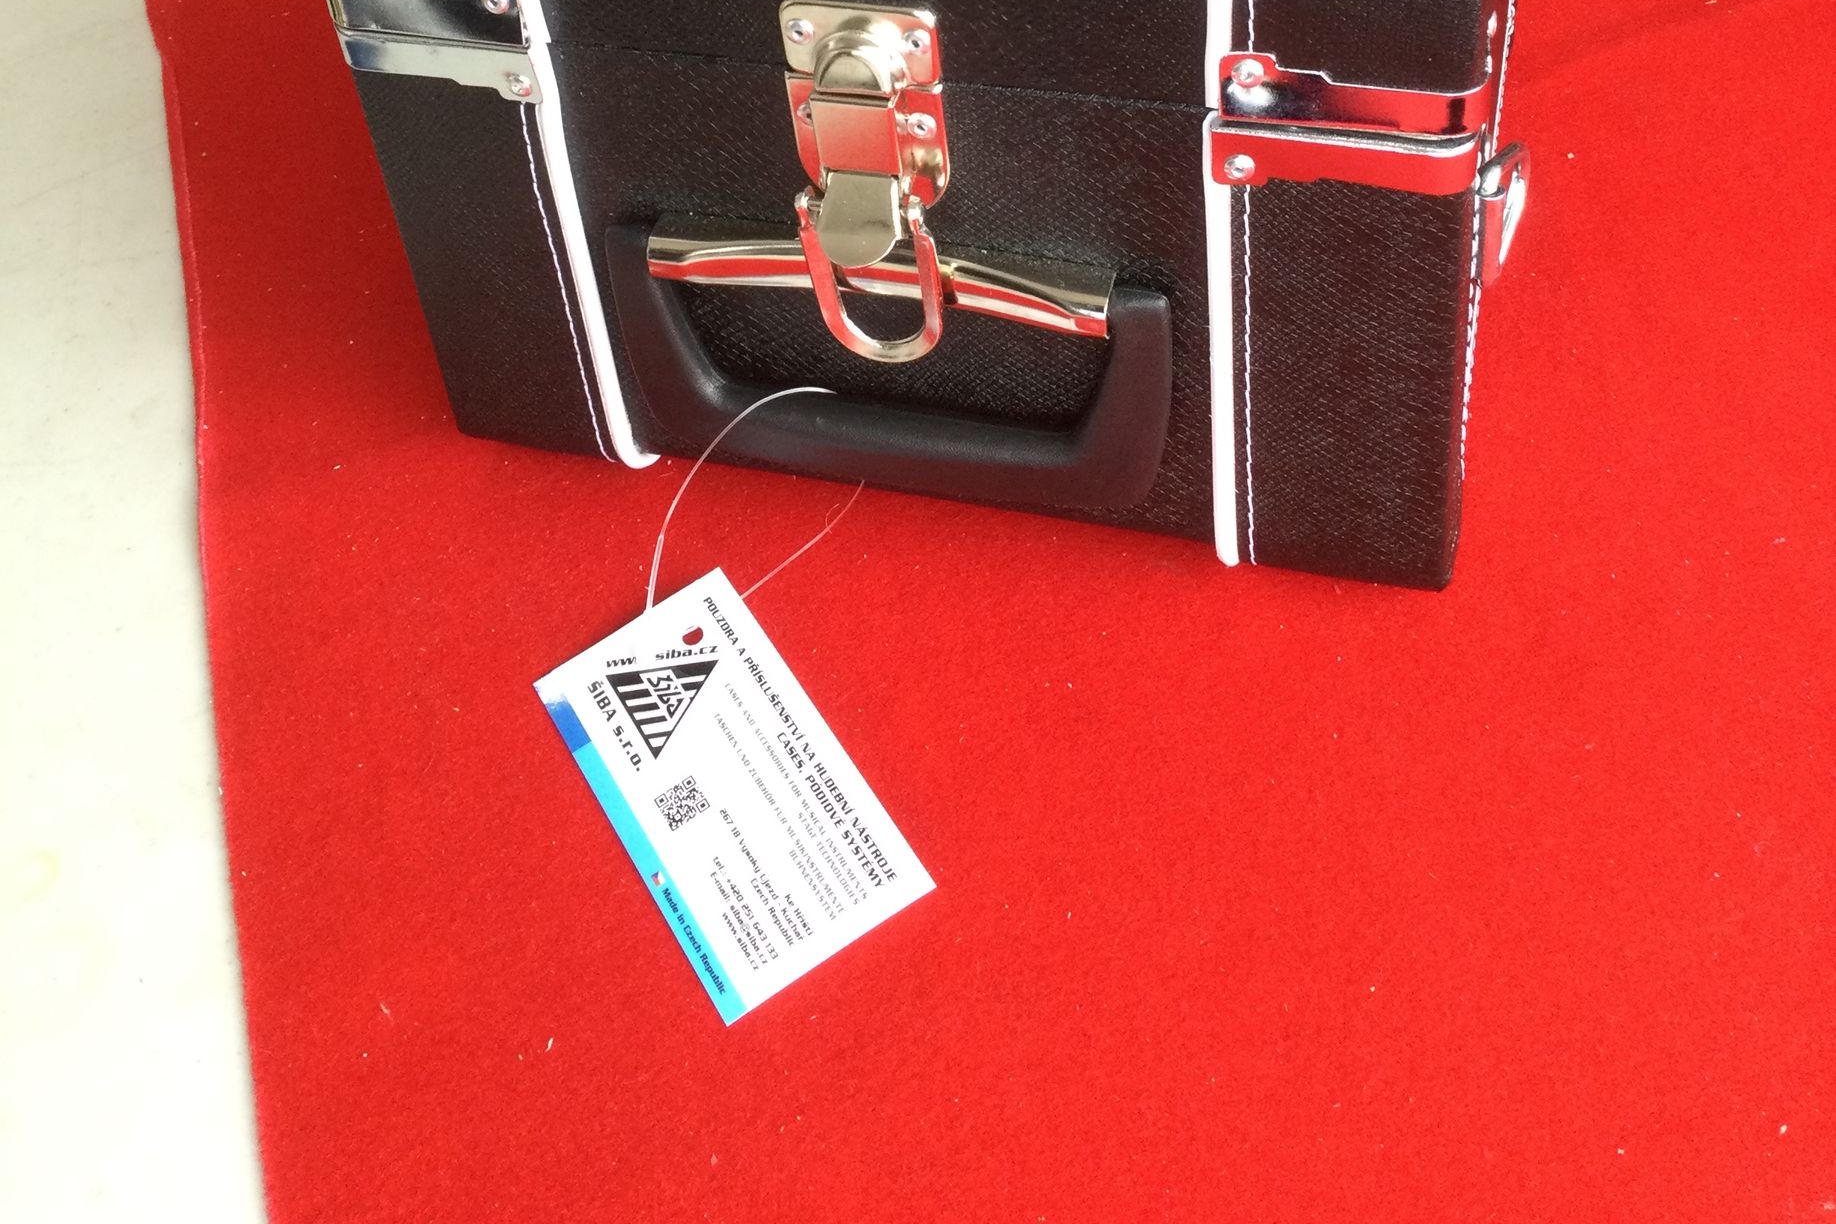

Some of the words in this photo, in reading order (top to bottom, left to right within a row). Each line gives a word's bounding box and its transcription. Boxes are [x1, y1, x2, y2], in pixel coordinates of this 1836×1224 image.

[656, 646, 718, 660] siba.cz
[587, 678, 617, 721] ŠIBA
[613, 725, 642, 771] s.r.o.
[702, 596, 740, 645] POUZDRA
[735, 645, 747, 656] A
[800, 741, 817, 761] NA
[813, 761, 855, 816] HUDEBNÍ
[849, 815, 897, 882] NÁSTROJE
[718, 807, 733, 826] 267
[776, 731, 809, 774] CASES,
[840, 829, 885, 890] SYSTÉMY
[796, 811, 817, 840] STAGE
[815, 841, 860, 905] TECHNOLOGIES
[660, 887, 681, 913] Made
[676, 913, 687, 925] in
[724, 877, 744, 903] +420
[740, 903, 755, 920] 251
[751, 921, 768, 942] 643
[764, 942, 779, 960] 133
[749, 877, 770, 906] Czech
[766, 906, 796, 948] Republic
[681, 924, 704, 953] Czech
[697, 953, 728, 995] Republic
